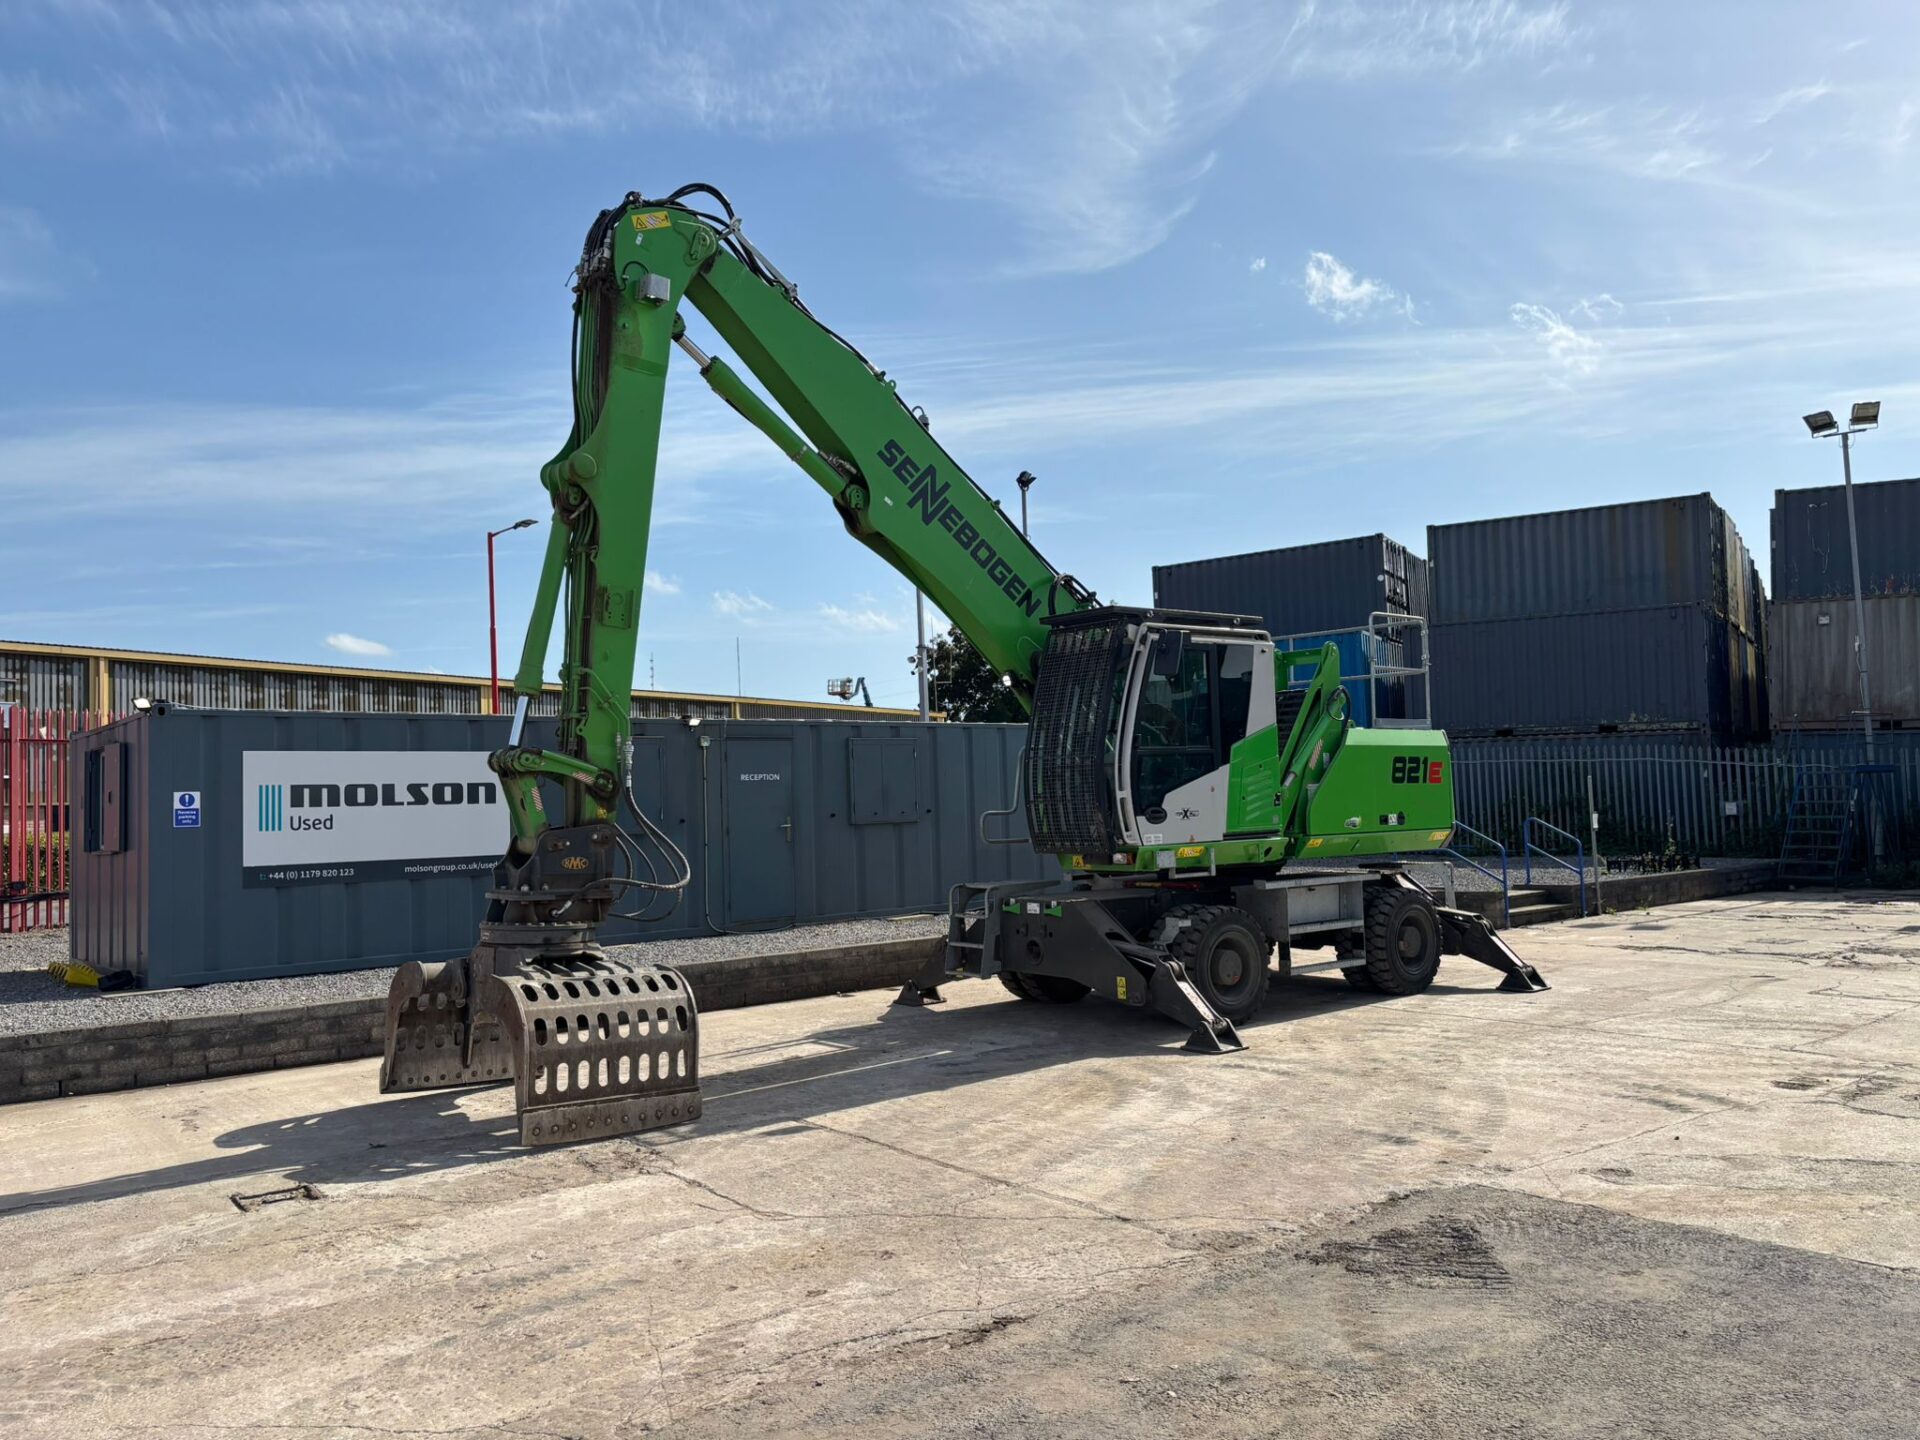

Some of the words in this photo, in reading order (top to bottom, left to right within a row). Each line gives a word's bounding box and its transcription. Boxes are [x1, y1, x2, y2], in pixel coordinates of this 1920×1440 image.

[876, 438, 1043, 618] SENNEBOGEN
[740, 773, 780, 781] RECEPTION
[1391, 756, 1443, 785] 821E
[290, 782, 497, 808] MOLSON
[289, 814, 334, 831] Used
[269, 871, 284, 880] +44
[286, 870, 299, 880] (0)
[300, 869, 321, 879] 1179
[322, 869, 338, 878] 820
[340, 868, 355, 877] 123
